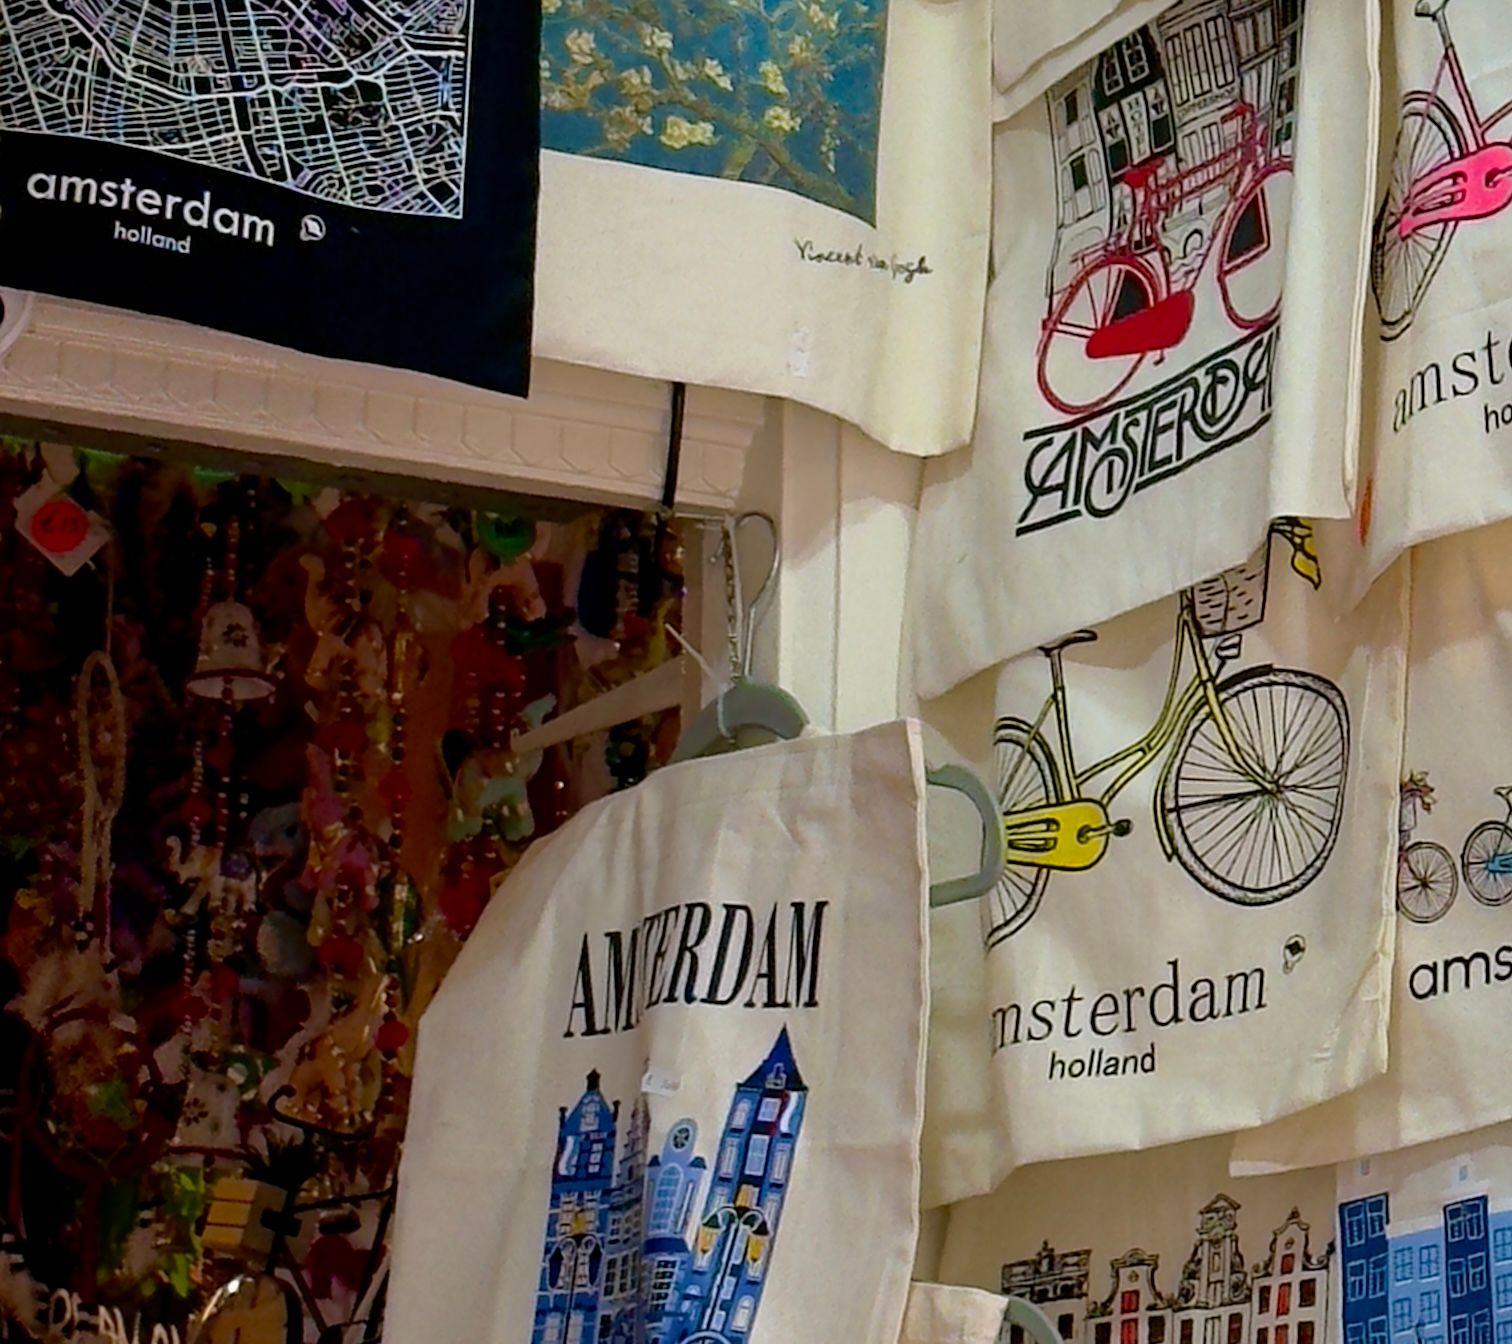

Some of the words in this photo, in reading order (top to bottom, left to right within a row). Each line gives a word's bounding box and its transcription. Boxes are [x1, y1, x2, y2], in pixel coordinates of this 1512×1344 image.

[26, 168, 275, 246] amsterdam
[114, 221, 190, 254] holland
[1017, 330, 1278, 536] AMSTERDA
[564, 901, 830, 1038] AMTERDAM
[993, 961, 1265, 1055] msterdam
[1049, 1044, 1155, 1080] holland
